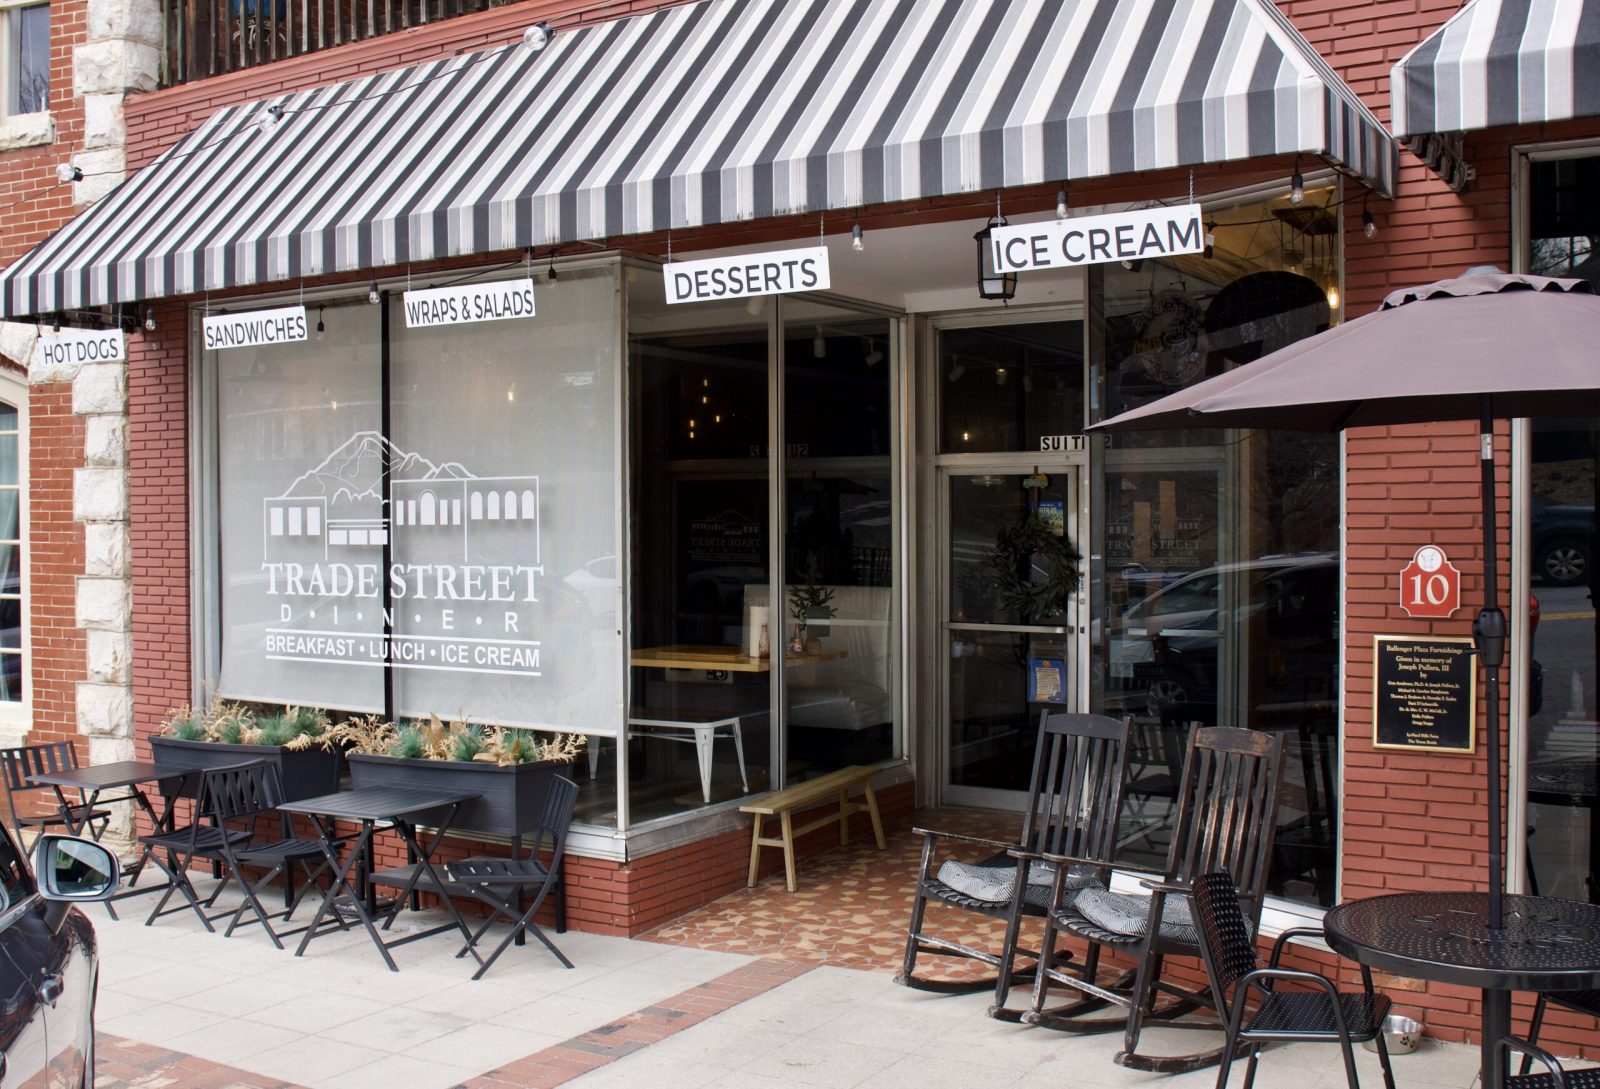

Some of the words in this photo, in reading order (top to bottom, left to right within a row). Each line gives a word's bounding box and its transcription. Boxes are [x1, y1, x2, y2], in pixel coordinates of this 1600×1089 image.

[994, 234, 1051, 271] ICE
[1061, 217, 1201, 263] CREAM
[674, 258, 818, 300] DESSERTS
[406, 296, 458, 326] WRAPS
[461, 296, 472, 320] &
[474, 288, 534, 318] SALADS
[206, 315, 306, 348] SANDWICHES
[43, 342, 72, 365] HOT
[76, 338, 119, 362] DOGS
[260, 562, 380, 598] TRADE
[389, 563, 544, 603] STREET
[1410, 574, 1450, 605] 10
[265, 634, 356, 658] BREAKFAST
[368, 640, 426, 662] LUNCH
[440, 644, 470, 664] ICE
[474, 646, 540, 668] CREAM
[1386, 644, 1413, 653] Ballenger
[1429, 646, 1463, 655] Furnishings
